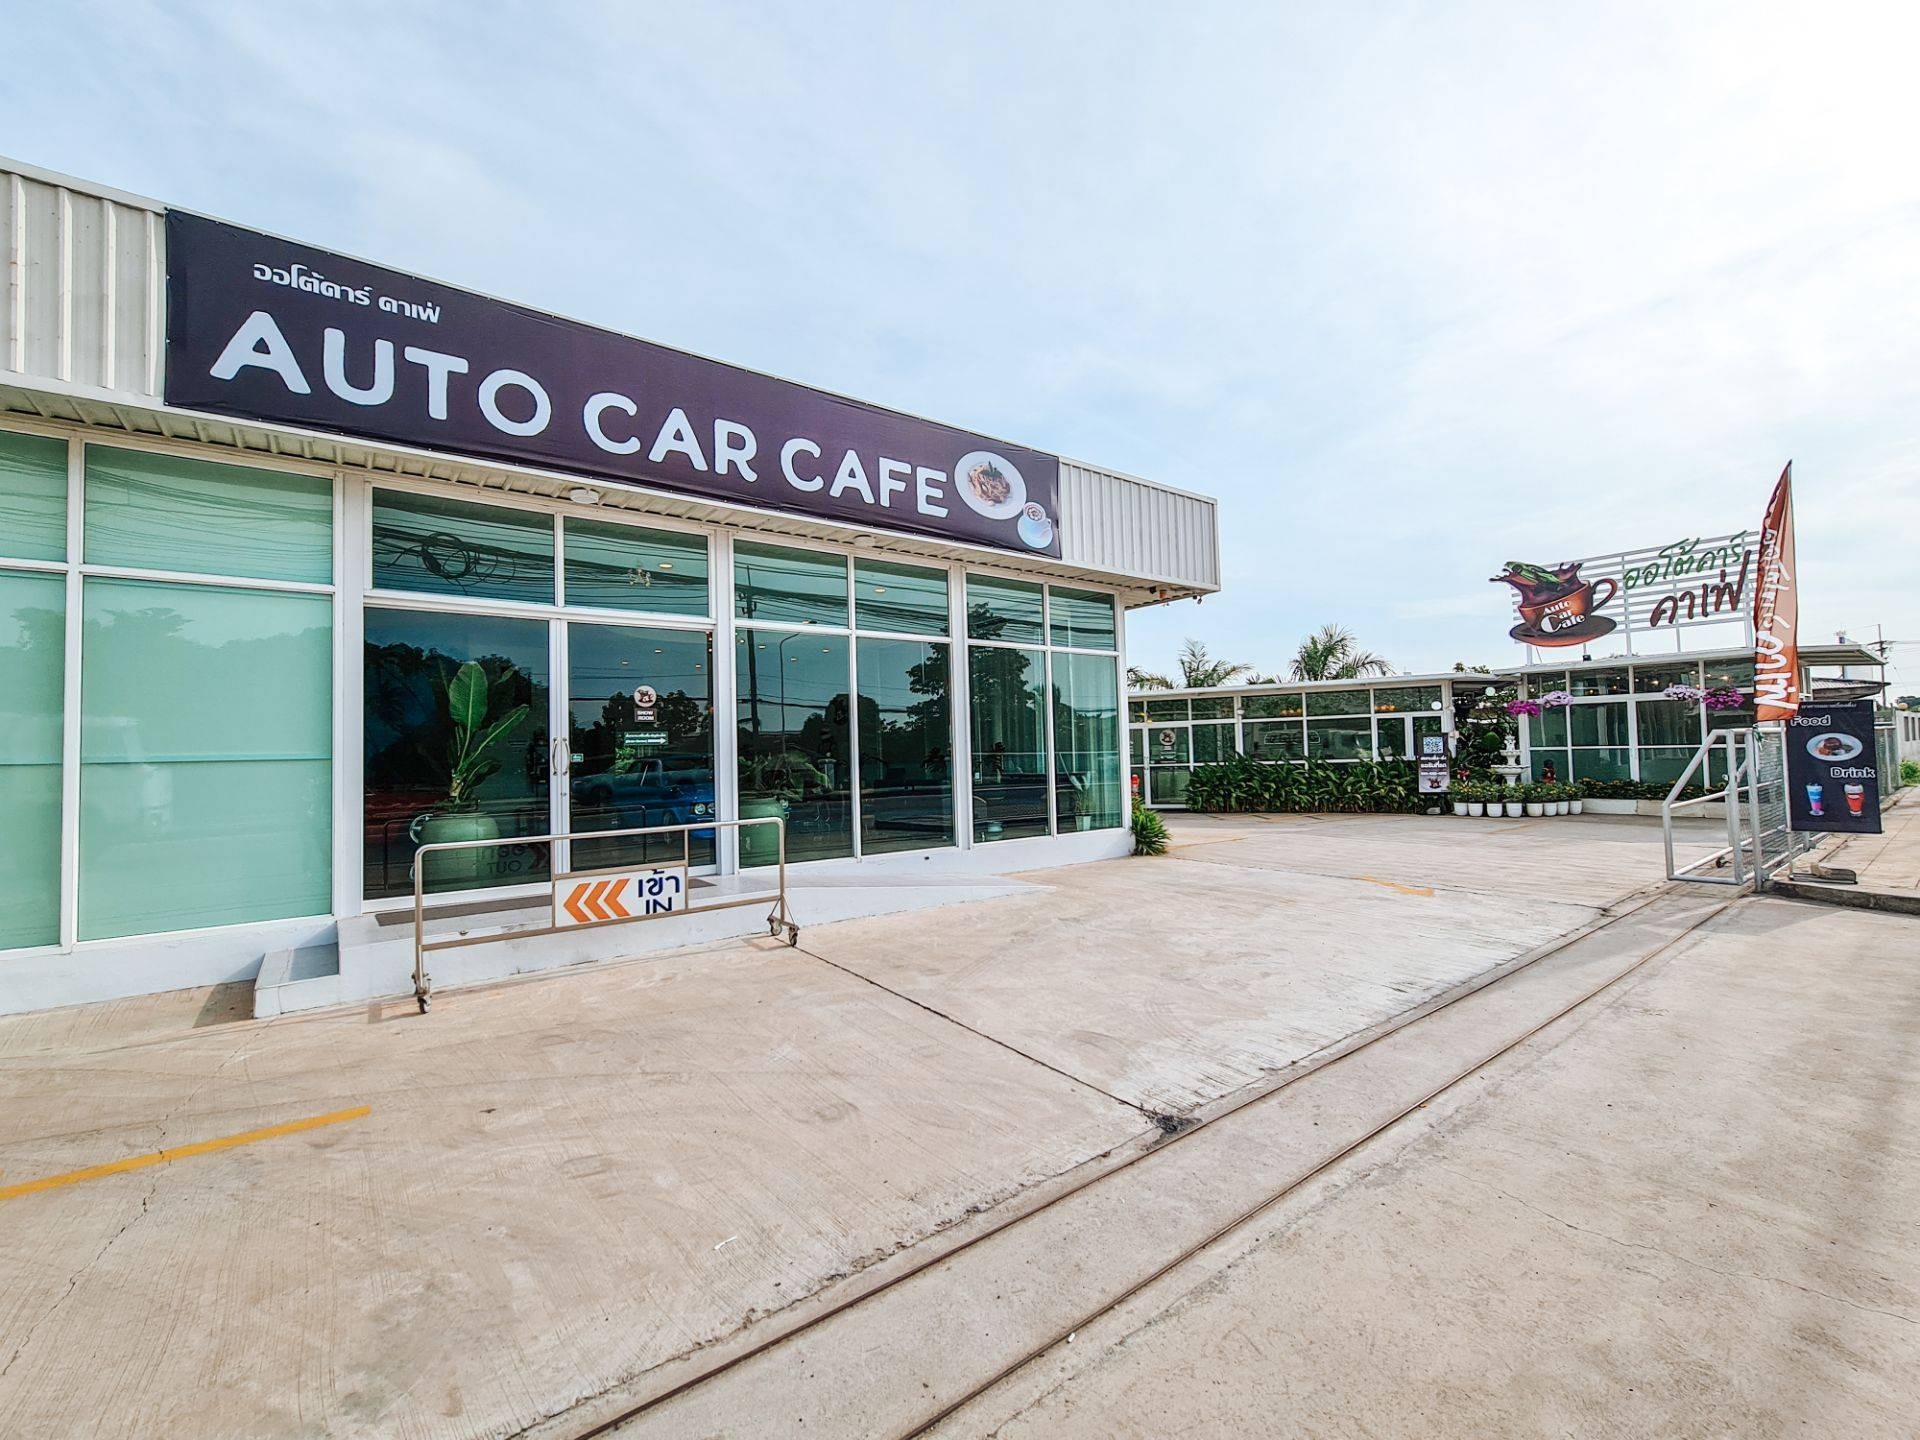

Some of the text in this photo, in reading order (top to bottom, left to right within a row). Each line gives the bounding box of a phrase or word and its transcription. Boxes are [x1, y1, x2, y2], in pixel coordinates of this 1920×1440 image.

[209, 310, 950, 518] AUTO CAR CAFE
[1650, 550, 1752, 627] คาเฟ่
[1543, 601, 1570, 615] Auto
[1790, 714, 1831, 726] Food
[1830, 766, 1876, 778] Drink
[638, 868, 680, 897] เข้า
[645, 897, 673, 914] IN
